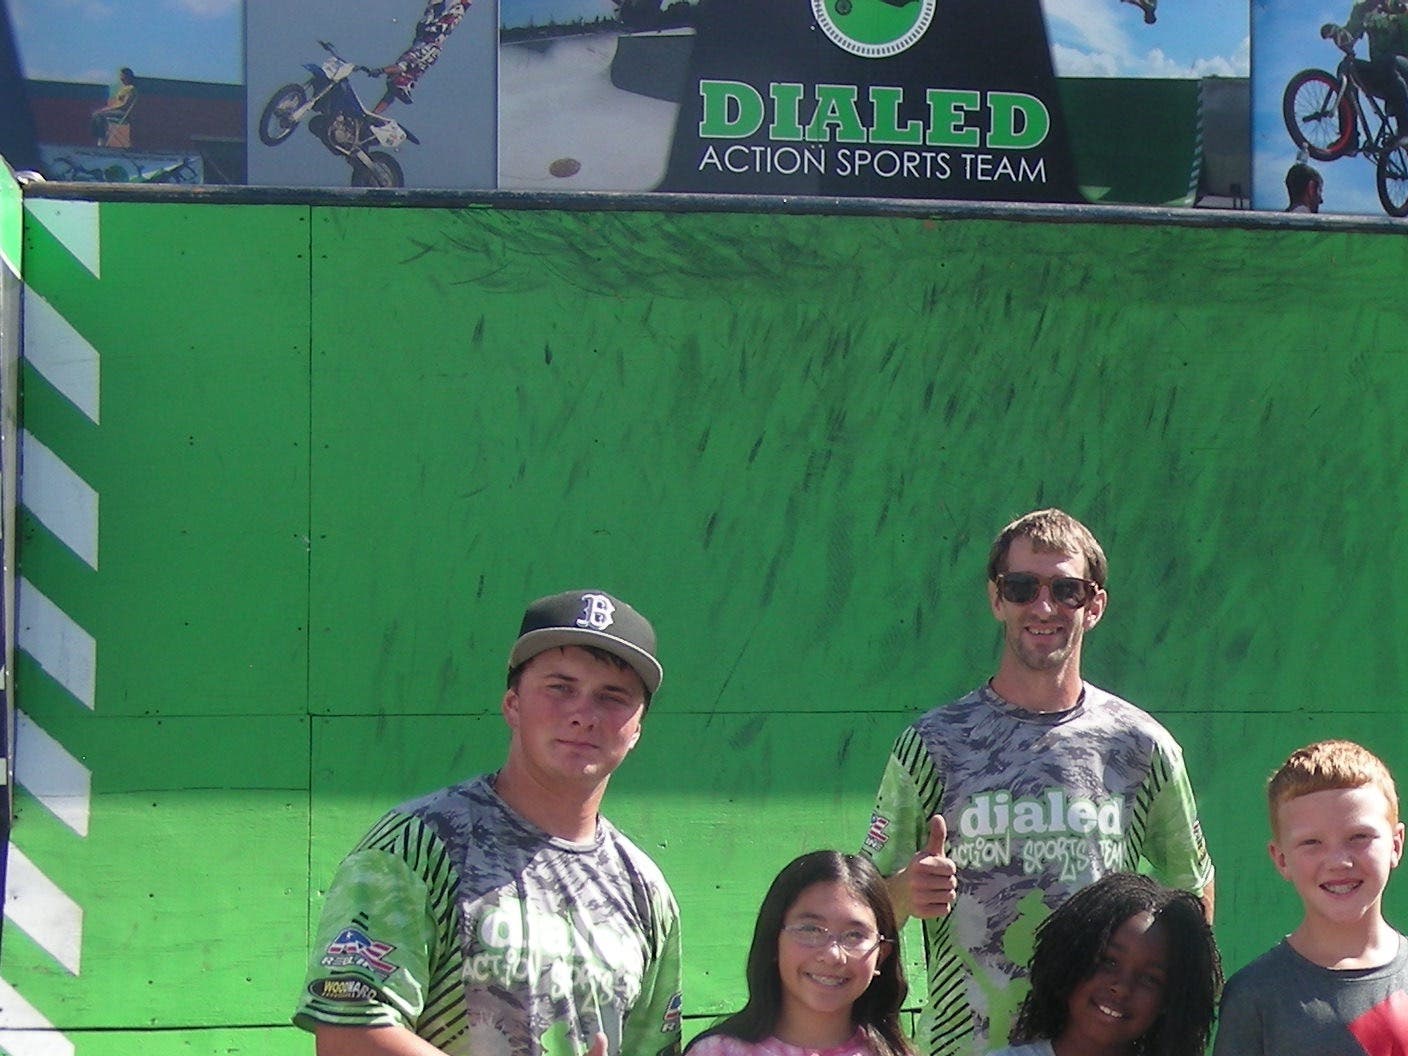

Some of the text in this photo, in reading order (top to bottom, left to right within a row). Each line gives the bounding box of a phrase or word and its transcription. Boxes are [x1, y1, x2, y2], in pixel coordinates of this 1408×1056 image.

[699, 79, 1051, 150] DIALED
[699, 145, 1047, 182] ACTION SPORTS TEAM
[576, 593, 616, 631] B
[960, 790, 1125, 838] dialed
